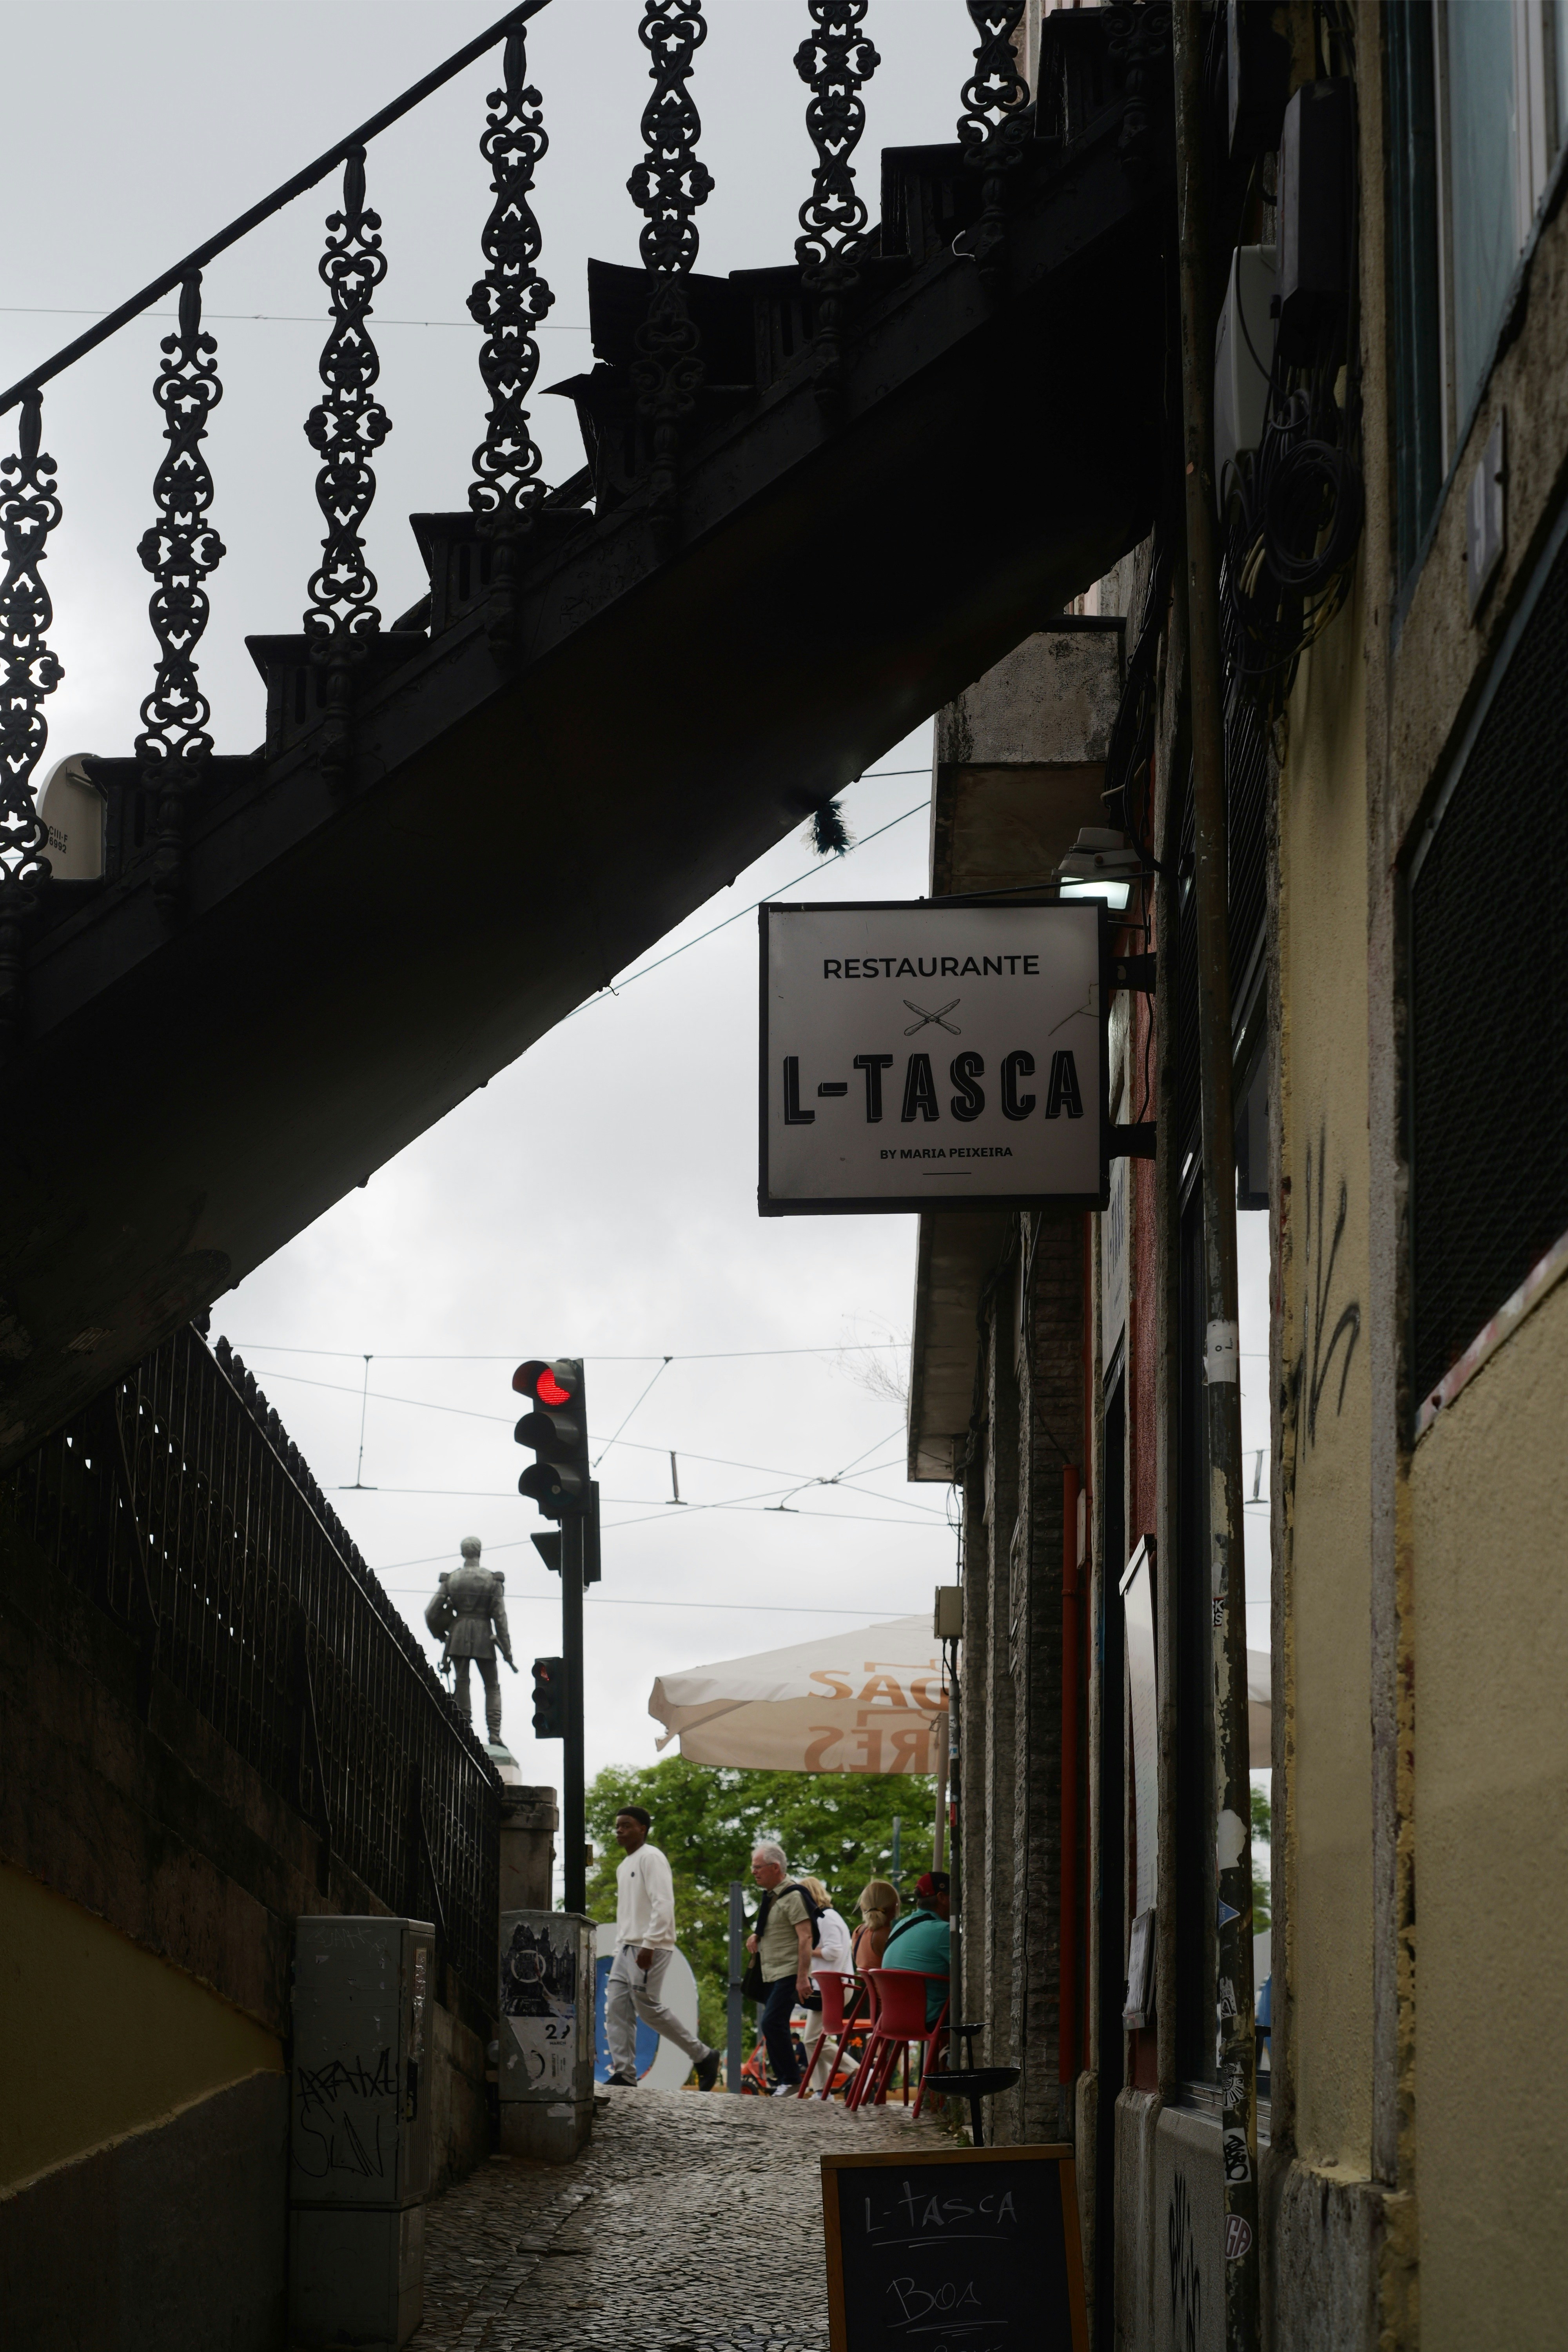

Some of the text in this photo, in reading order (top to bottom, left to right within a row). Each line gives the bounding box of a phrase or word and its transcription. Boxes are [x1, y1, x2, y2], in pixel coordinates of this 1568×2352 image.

[49, 837, 67, 854] 6992
[824, 955, 1040, 979] RESTAURANTE
[783, 1050, 1085, 1125] L-TASCA
[880, 1147, 1013, 1159] BY MARIA PEIXEIRA
[886, 2277, 982, 2328] BOA
